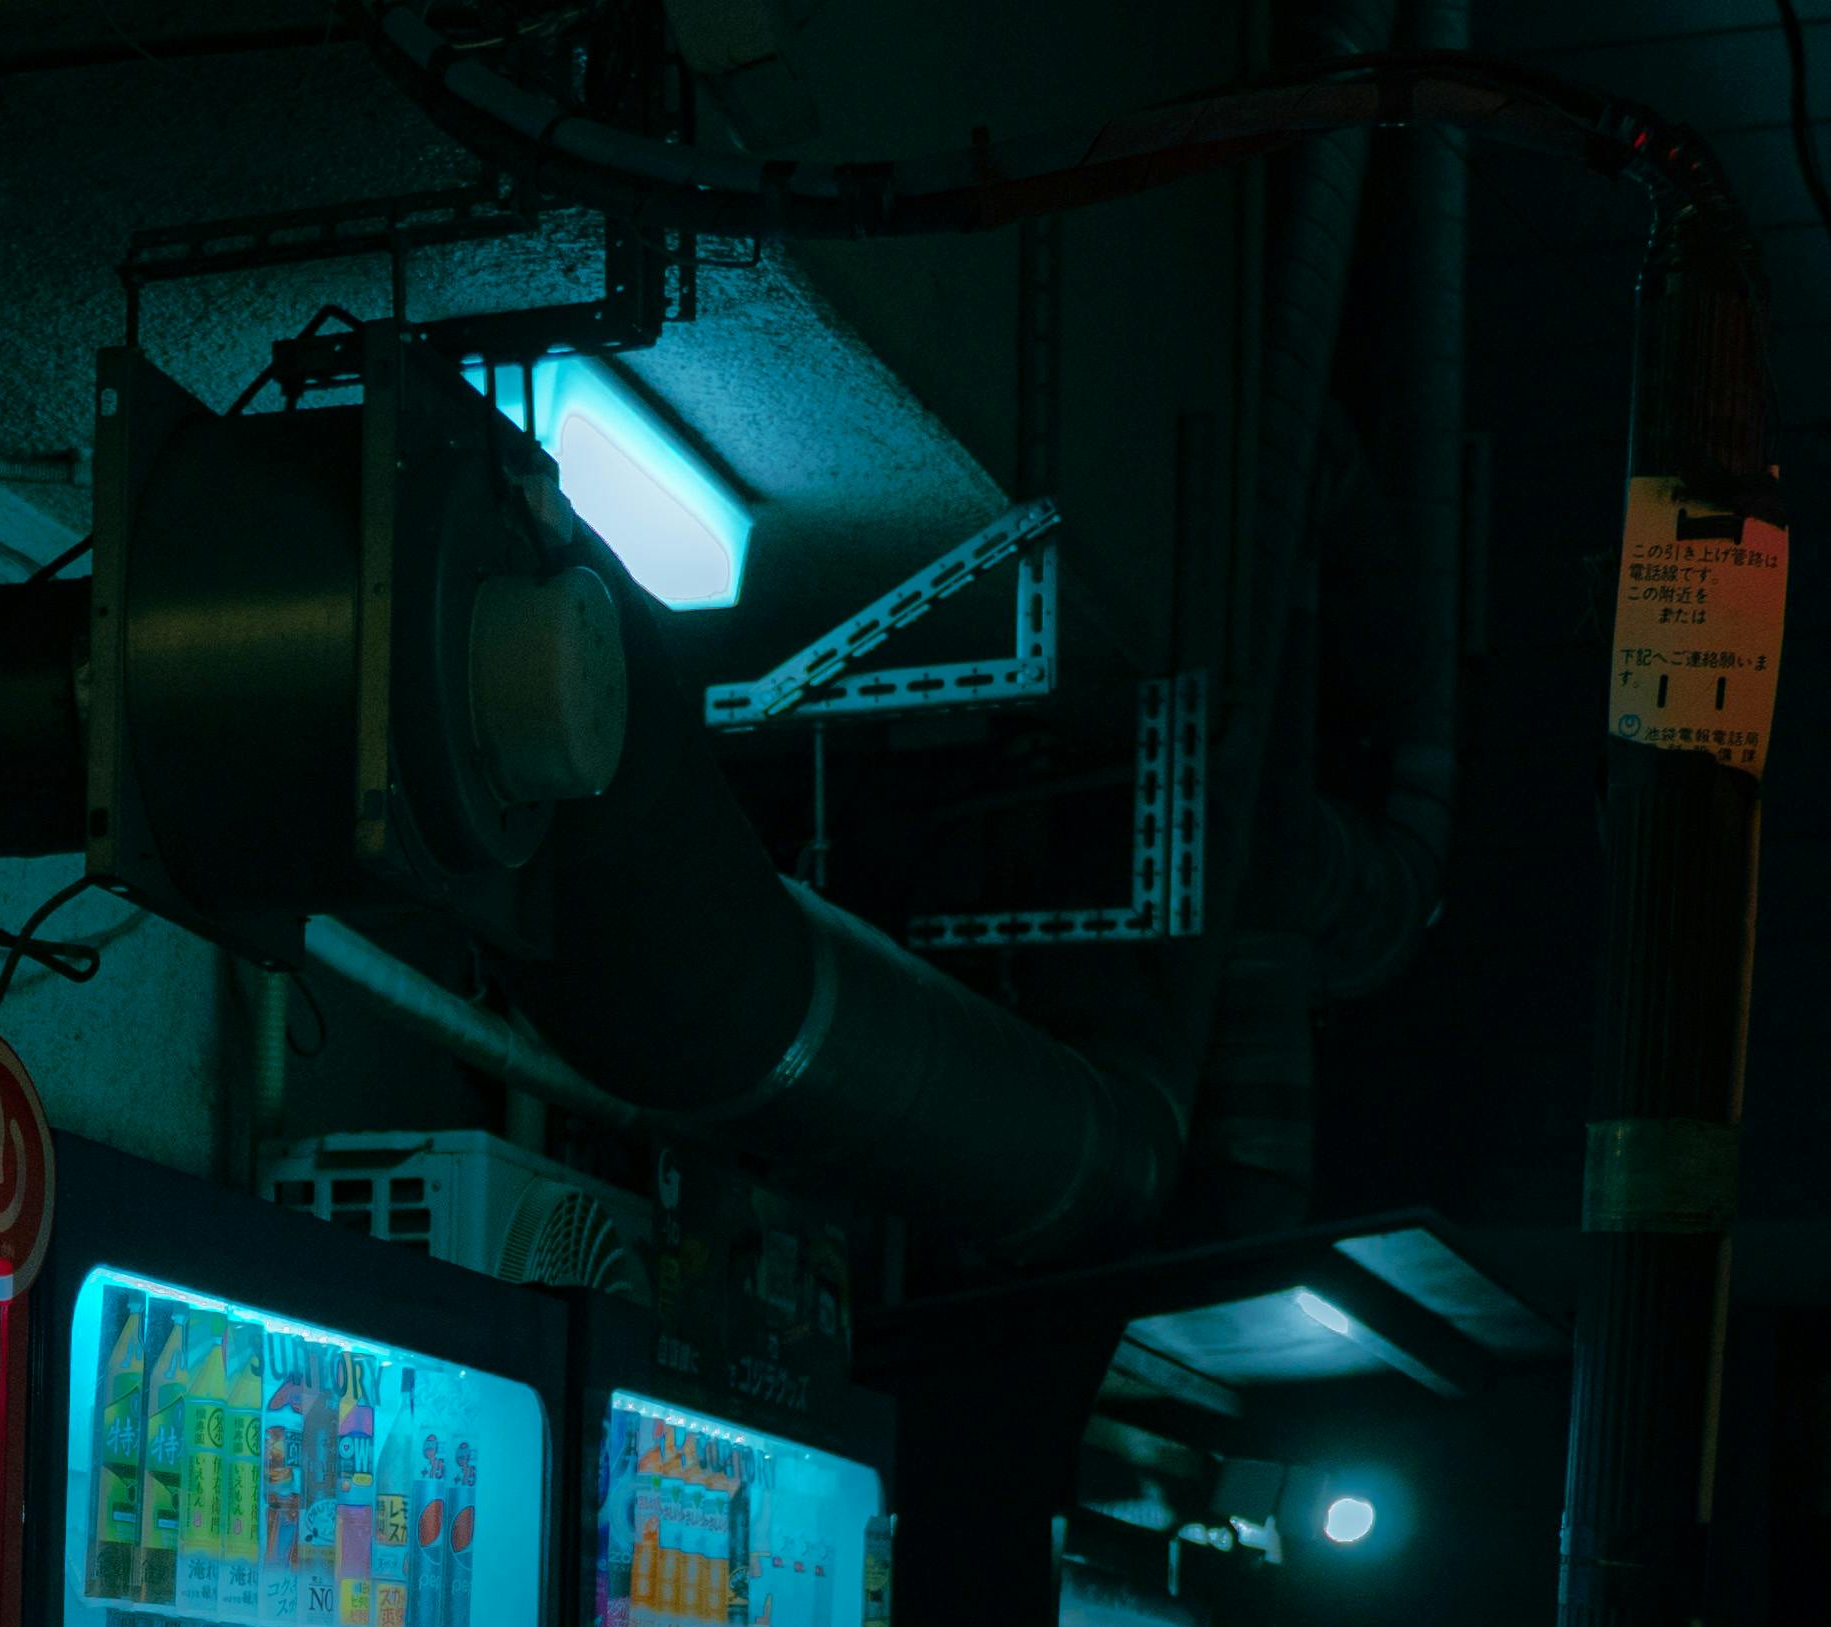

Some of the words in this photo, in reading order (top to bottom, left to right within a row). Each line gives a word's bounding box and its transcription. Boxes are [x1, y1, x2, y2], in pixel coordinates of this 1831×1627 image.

[1632, 543, 1778, 568] この引き上げ管路は
[1630, 564, 1718, 585] 電話線です。
[1659, 608, 1706, 624] または
